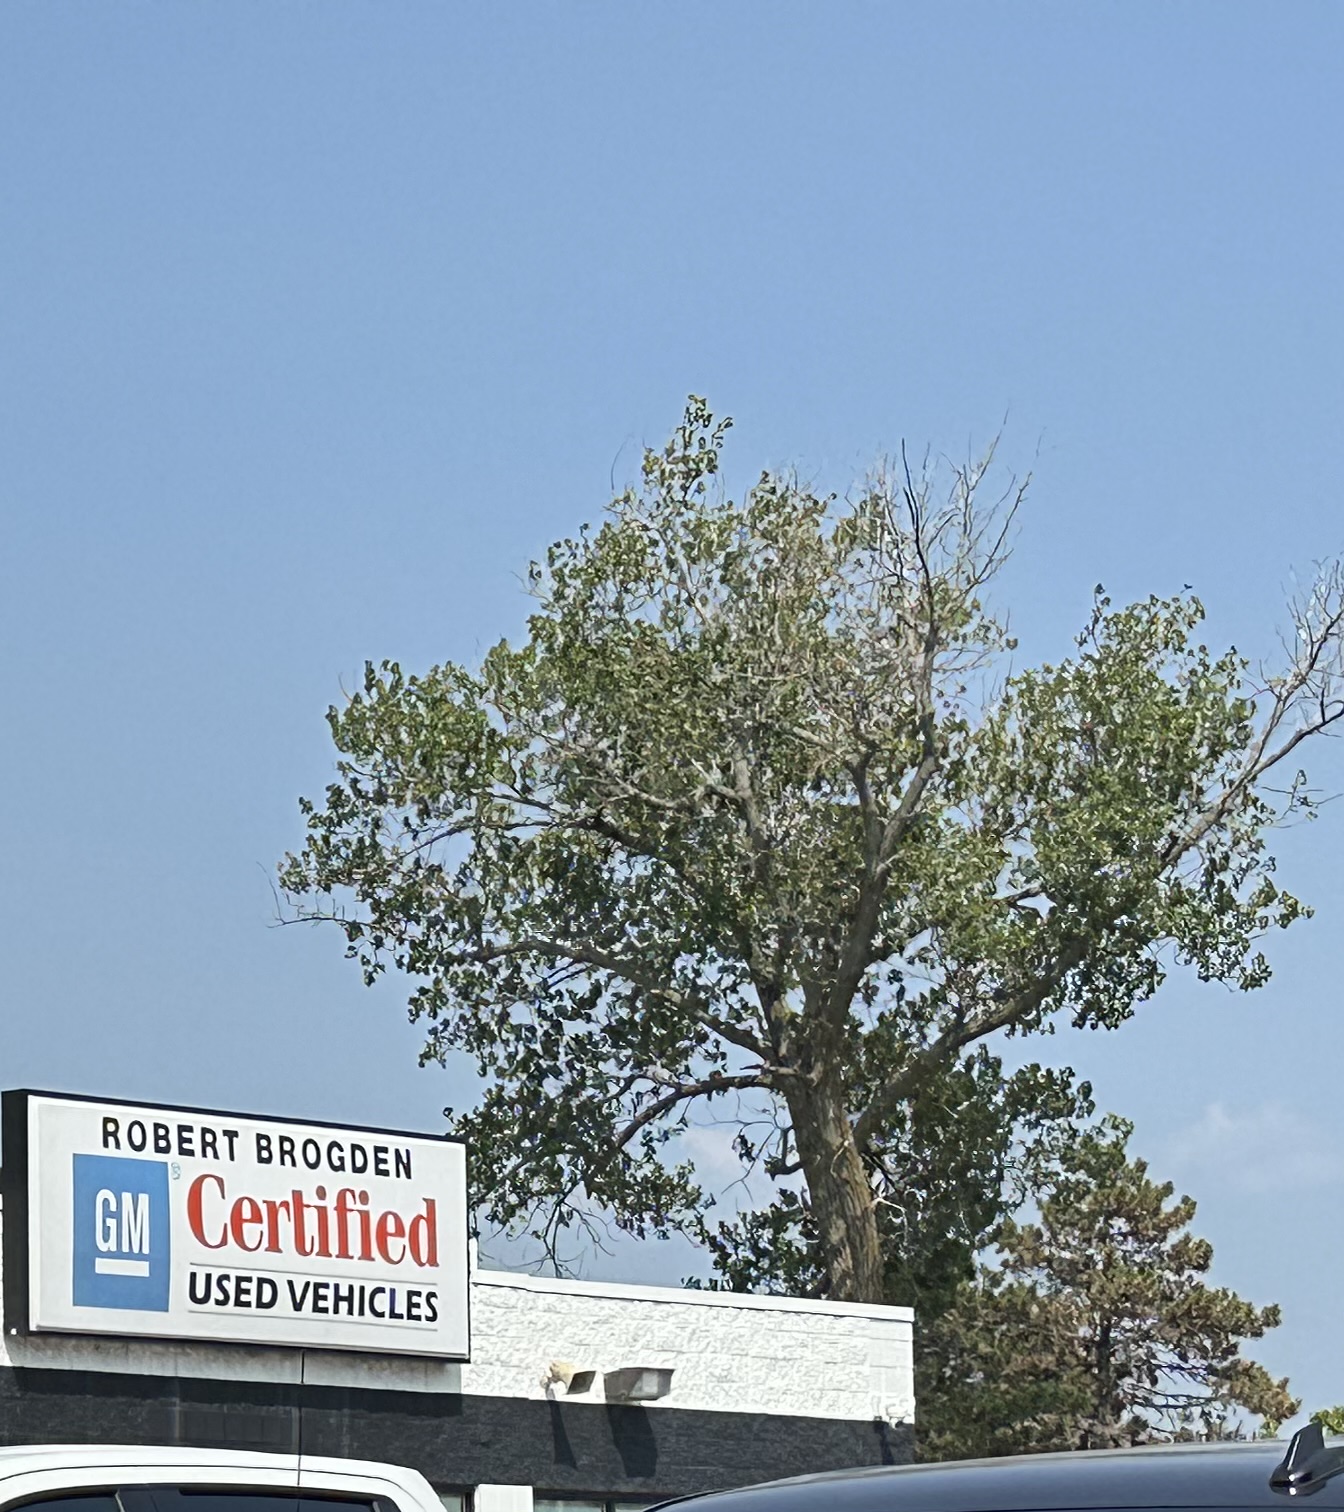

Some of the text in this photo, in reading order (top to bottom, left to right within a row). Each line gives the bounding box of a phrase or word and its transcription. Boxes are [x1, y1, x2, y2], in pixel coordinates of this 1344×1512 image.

[102, 1116, 413, 1180] ROBERT BROGDEN
[95, 1188, 150, 1254] GM
[187, 1173, 440, 1268] Certified
[189, 1272, 439, 1323] USED VEHICLES
